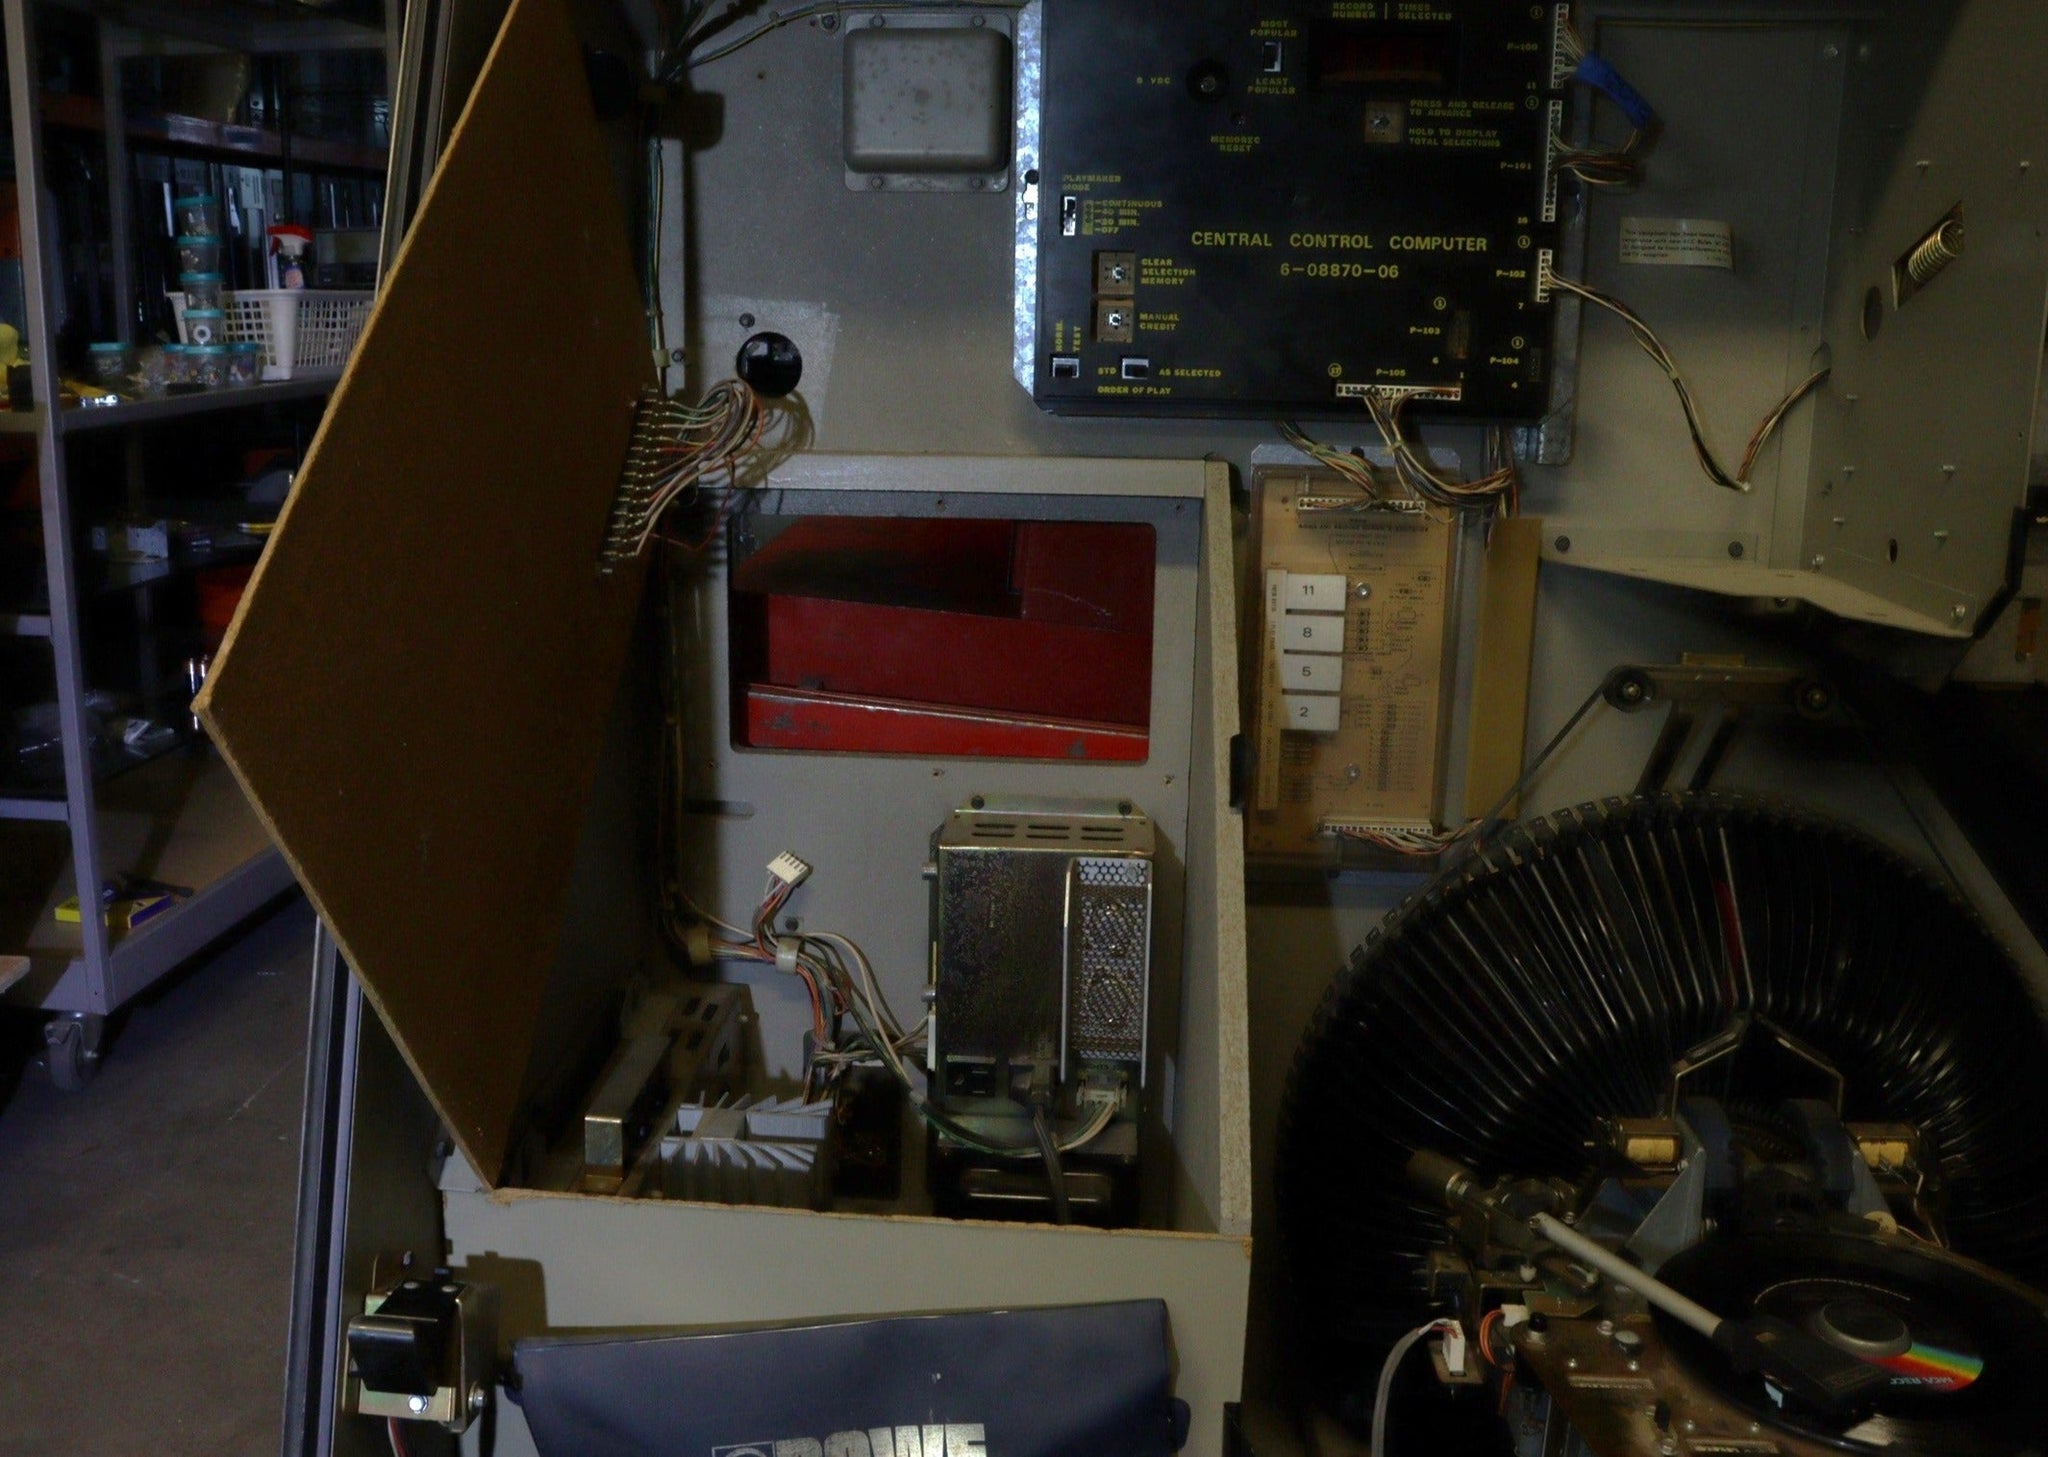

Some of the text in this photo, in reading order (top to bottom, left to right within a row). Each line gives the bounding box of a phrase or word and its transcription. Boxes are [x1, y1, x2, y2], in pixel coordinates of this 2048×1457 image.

[1332, 2, 1374, 10] RECORD
[1331, 11, 1376, 19] NUMBER
[1397, 11, 1452, 21] SELECTED
[1260, 20, 1289, 28] MOST
[1250, 29, 1297, 37] POPULAR
[1506, 43, 1539, 51] P-100
[1256, 77, 1288, 85] LEAST
[1247, 86, 1296, 95] POPULAR
[1409, 99, 1515, 110] PRESS AND RELEASE
[1409, 108, 1473, 118] TO ADVANCE
[1408, 128, 1498, 138] HOLD TO DISPLAY
[1409, 138, 1501, 148] TOTAL SELECTIONS
[1219, 144, 1252, 152] RESET
[1500, 162, 1532, 170] P-101
[1063, 174, 1122, 183] PLAYMAKER
[1063, 183, 1090, 191] MODE
[1191, 231, 1488, 251] CENTRAL CONTROL COMPUTER
[1141, 258, 1173, 266] CLEAR
[1142, 268, 1196, 276] SELECTION
[1280, 263, 1399, 279] 6-08870-06
[1496, 270, 1526, 278] P-102
[1140, 277, 1185, 285] MEMORY
[1139, 312, 1180, 321] MANUAL
[1139, 322, 1176, 331] CREDIT
[1410, 326, 1440, 335] P-103
[1072, 326, 1081, 352] TEST
[1489, 357, 1519, 365] P-104
[1097, 367, 1117, 376] STD
[1159, 369, 1222, 377] AS SELECTED
[1376, 369, 1406, 377] P-105
[1097, 386, 1171, 395] ORDER OF PLAY
[1302, 585, 1315, 595] 11
[1302, 627, 1312, 638] 8
[1302, 666, 1311, 677] 5
[1300, 706, 1308, 718] 2
